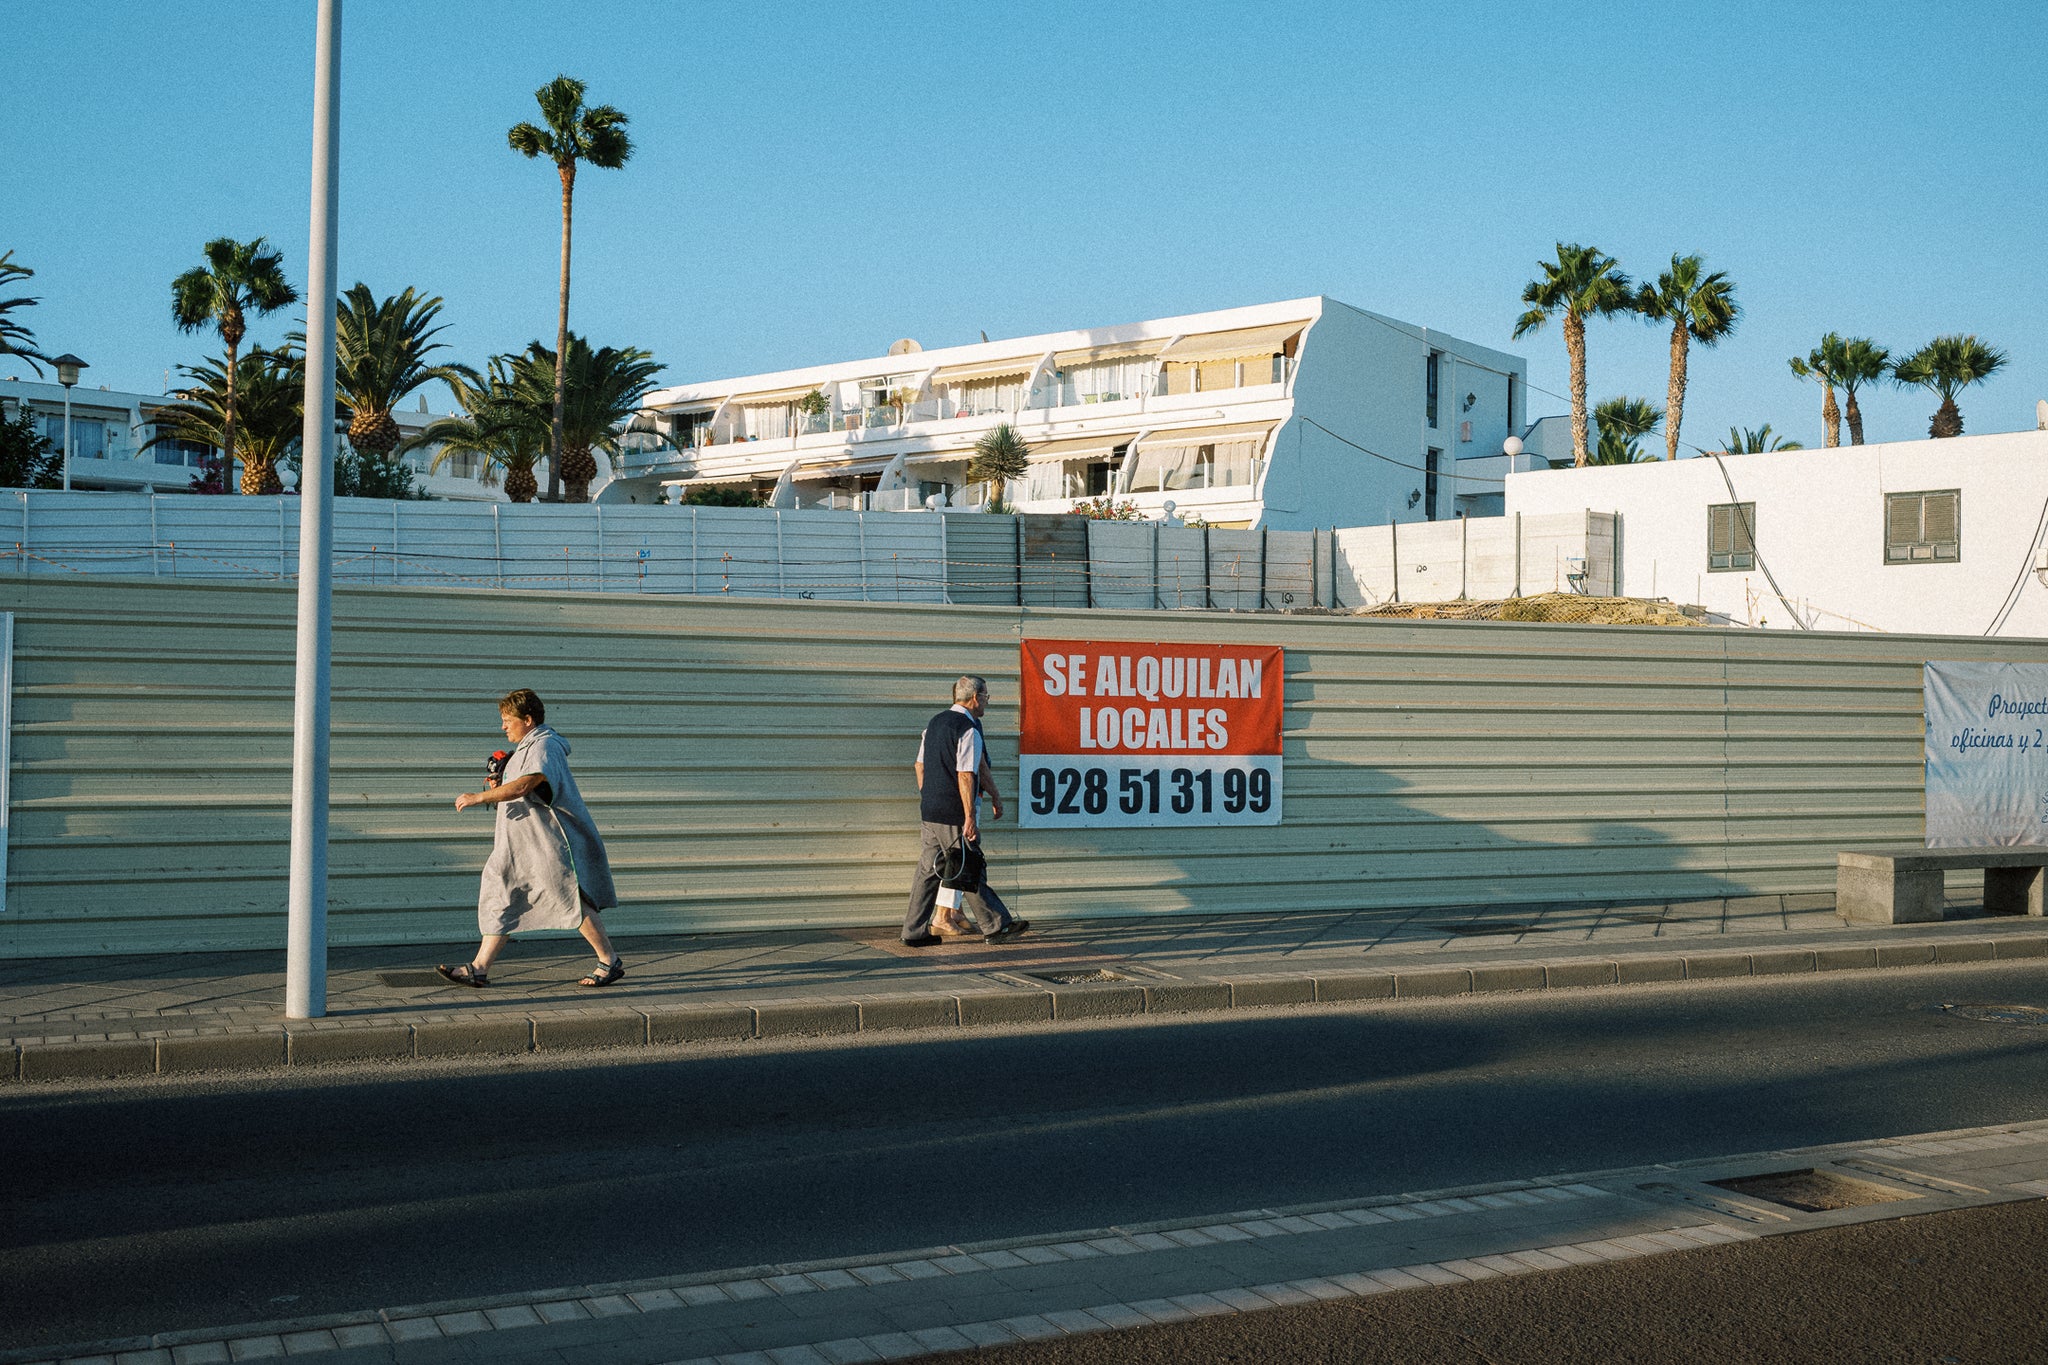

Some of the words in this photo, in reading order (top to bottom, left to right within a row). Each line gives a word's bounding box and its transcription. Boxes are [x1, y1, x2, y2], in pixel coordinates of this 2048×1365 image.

[1043, 653, 1087, 696] SE
[1095, 655, 1262, 702] ALQUILAN
[1079, 706, 1229, 750] LOCALES
[1989, 694, 2048, 720] Proyect
[1951, 727, 2013, 753] oficinas
[2018, 735, 2029, 754] y
[2033, 728, 2043, 748] 2
[1031, 767, 1108, 815] 928
[1119, 768, 1160, 814] 51
[1171, 768, 1212, 814] 31
[1223, 768, 1271, 813] 99
